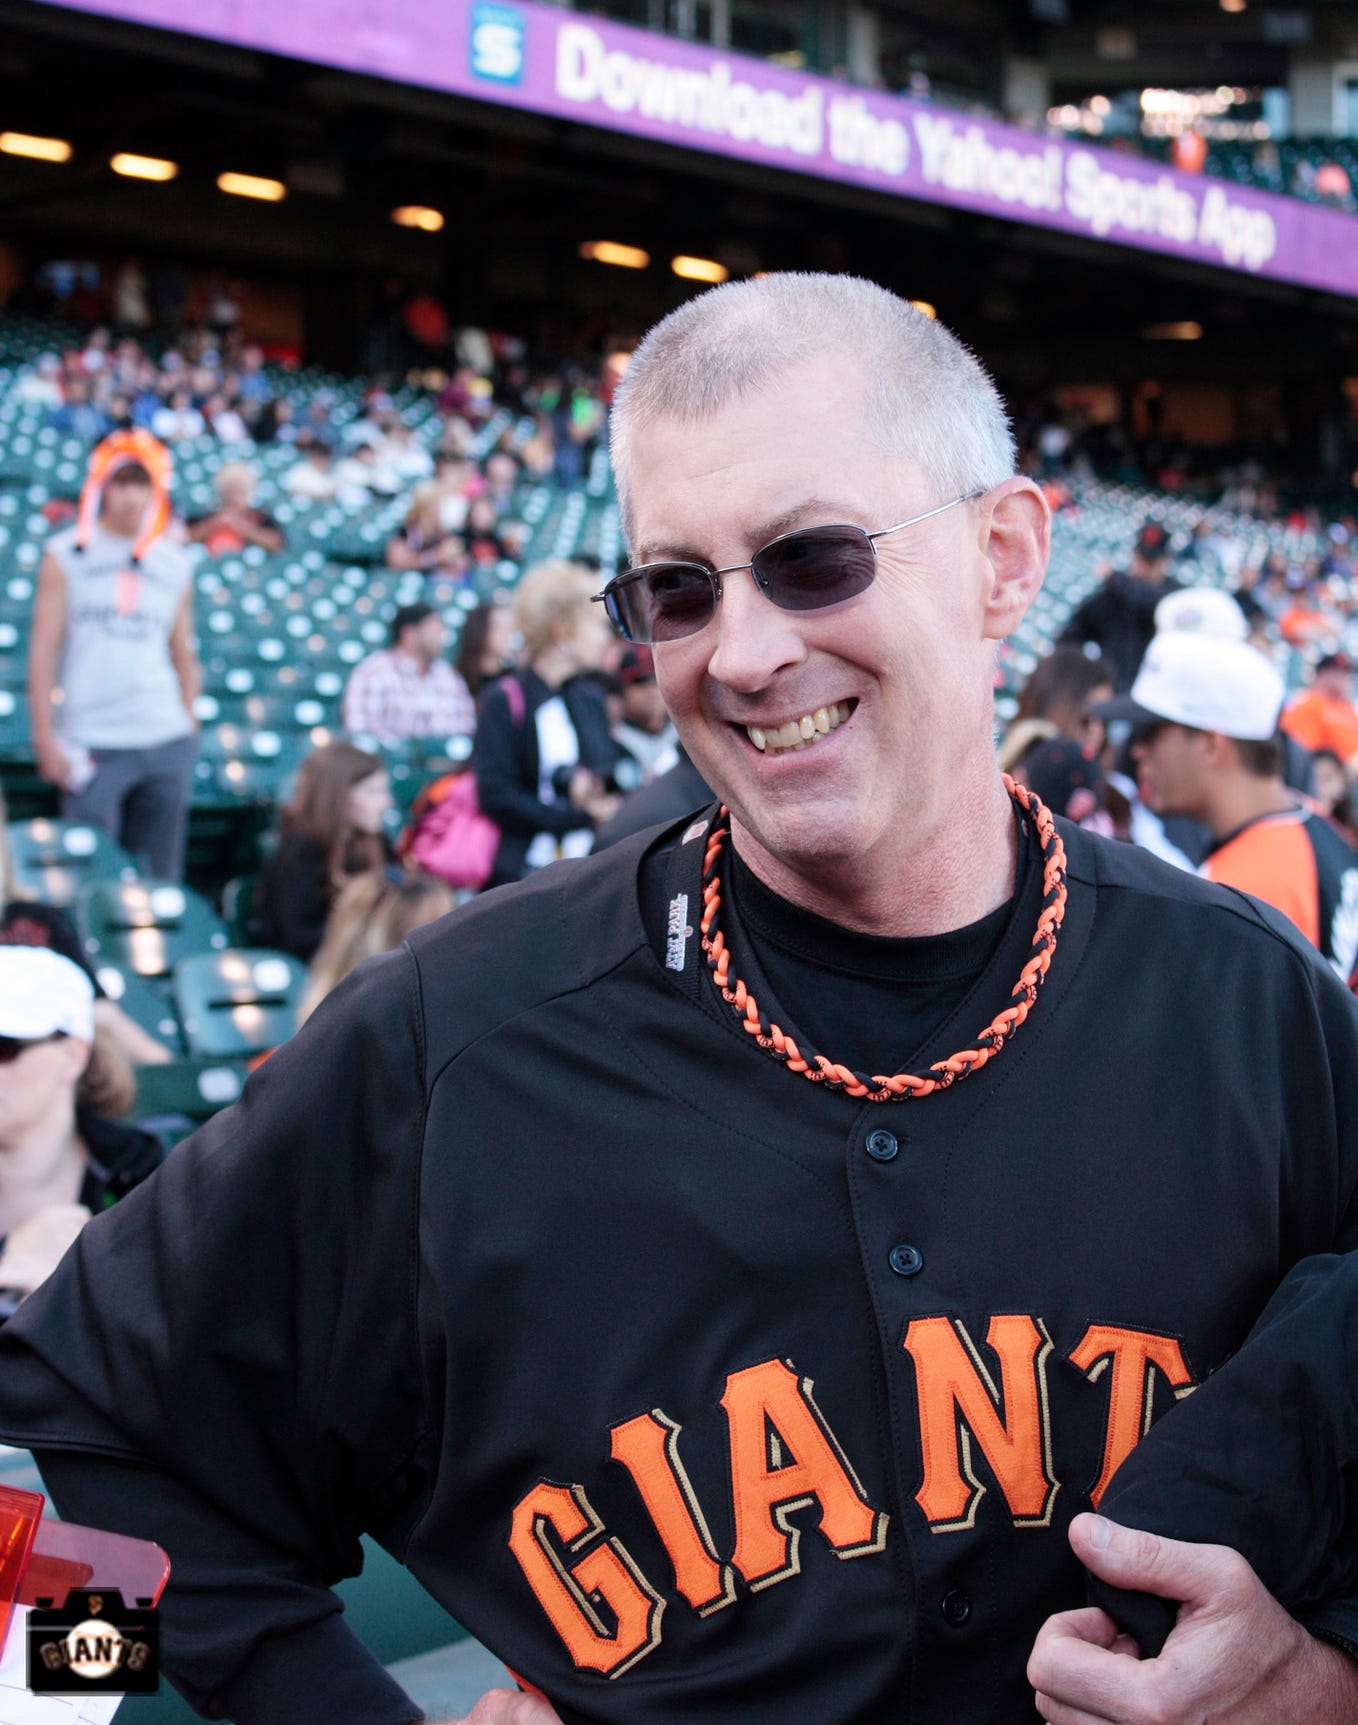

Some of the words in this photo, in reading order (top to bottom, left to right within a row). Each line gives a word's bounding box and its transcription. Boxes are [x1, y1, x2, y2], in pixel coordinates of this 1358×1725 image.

[555, 21, 823, 156] Download
[828, 95, 910, 176] the
[1065, 149, 1199, 237] Sports
[1201, 184, 1277, 271] App
[668, 893, 682, 936] PARK
